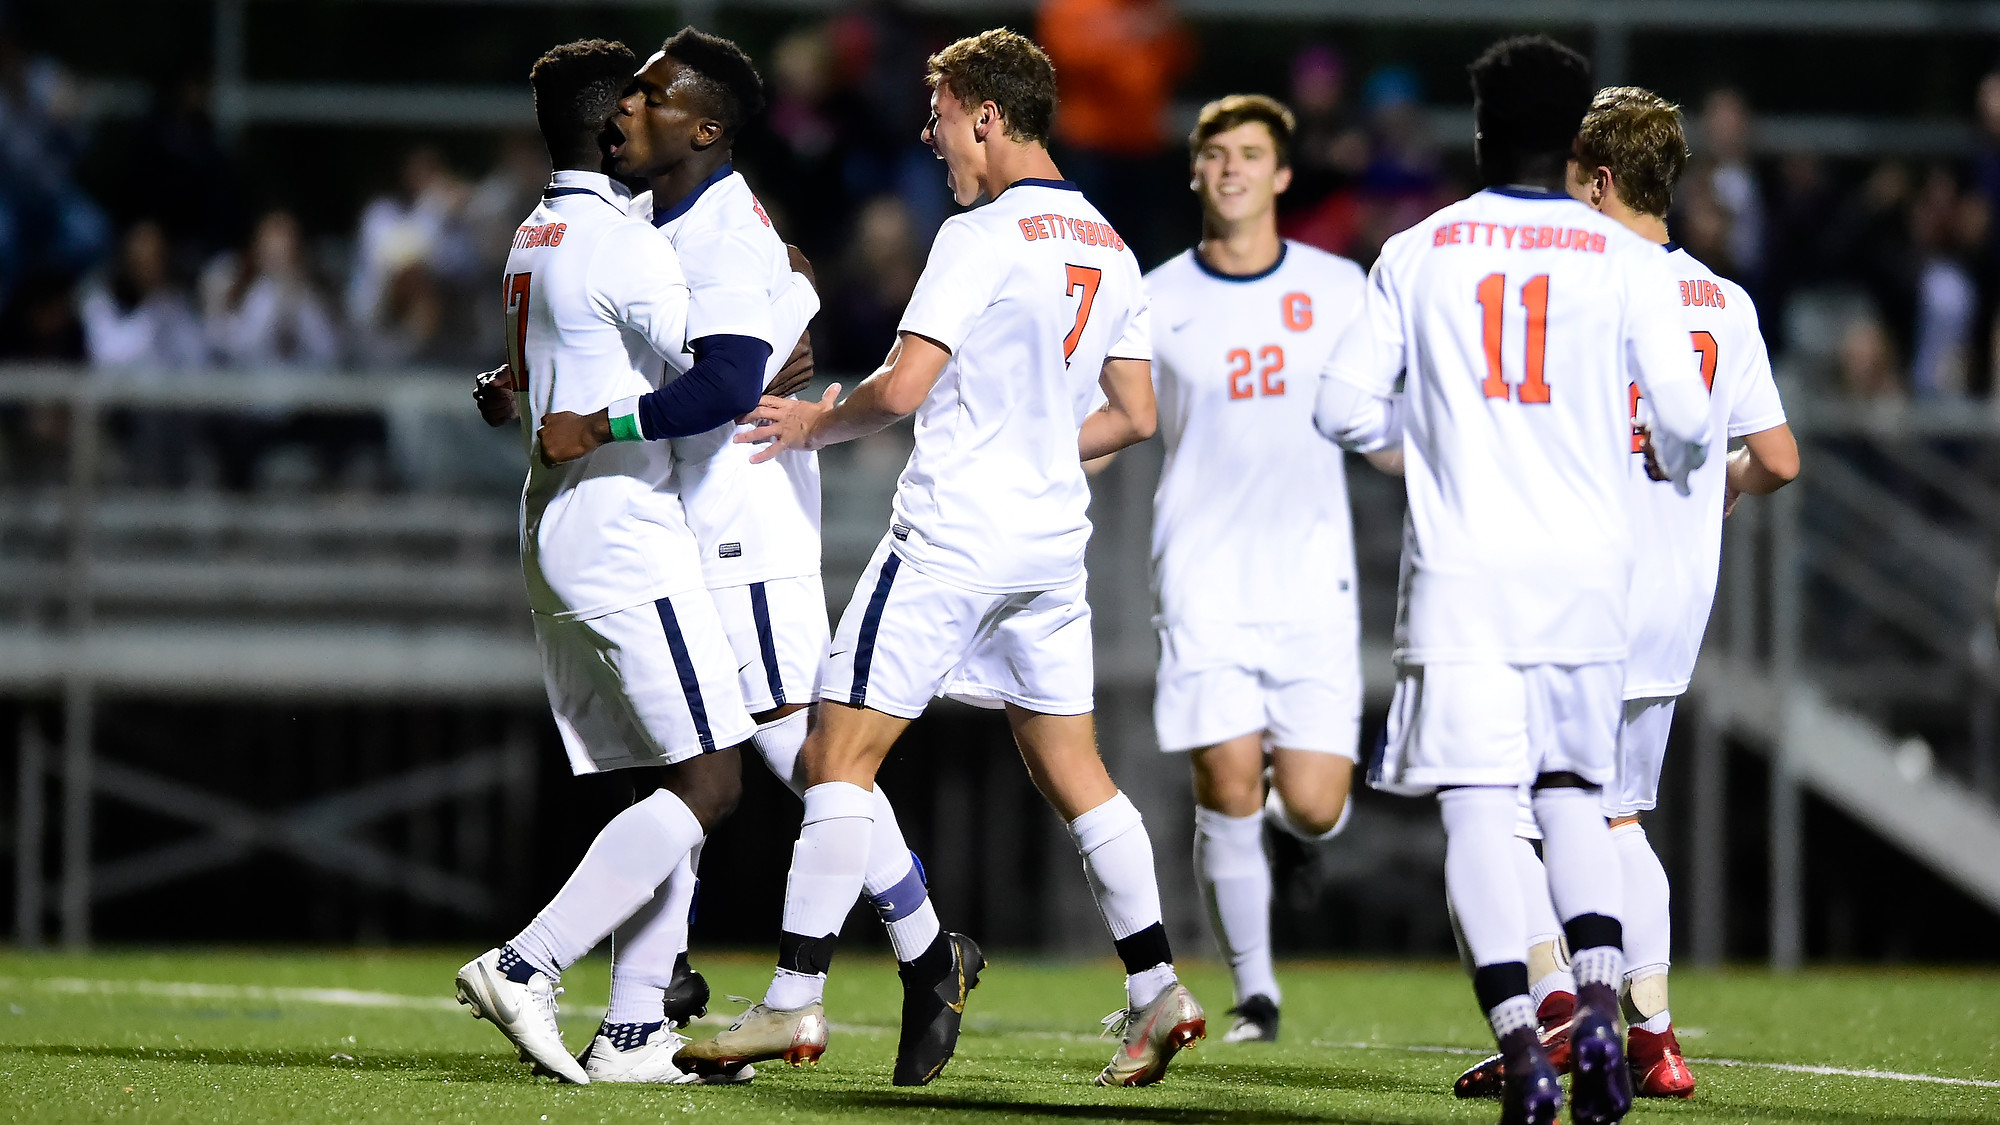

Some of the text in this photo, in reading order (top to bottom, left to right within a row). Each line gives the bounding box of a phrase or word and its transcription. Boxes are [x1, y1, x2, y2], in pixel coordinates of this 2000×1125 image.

[1018, 214, 1124, 251] GETTYSBURG
[1433, 221, 1606, 253] GETTYSBURG
[1063, 263, 1102, 371] 7
[1281, 291, 1314, 332] G
[1477, 273, 1550, 403] 11
[1227, 345, 1285, 400] 22
